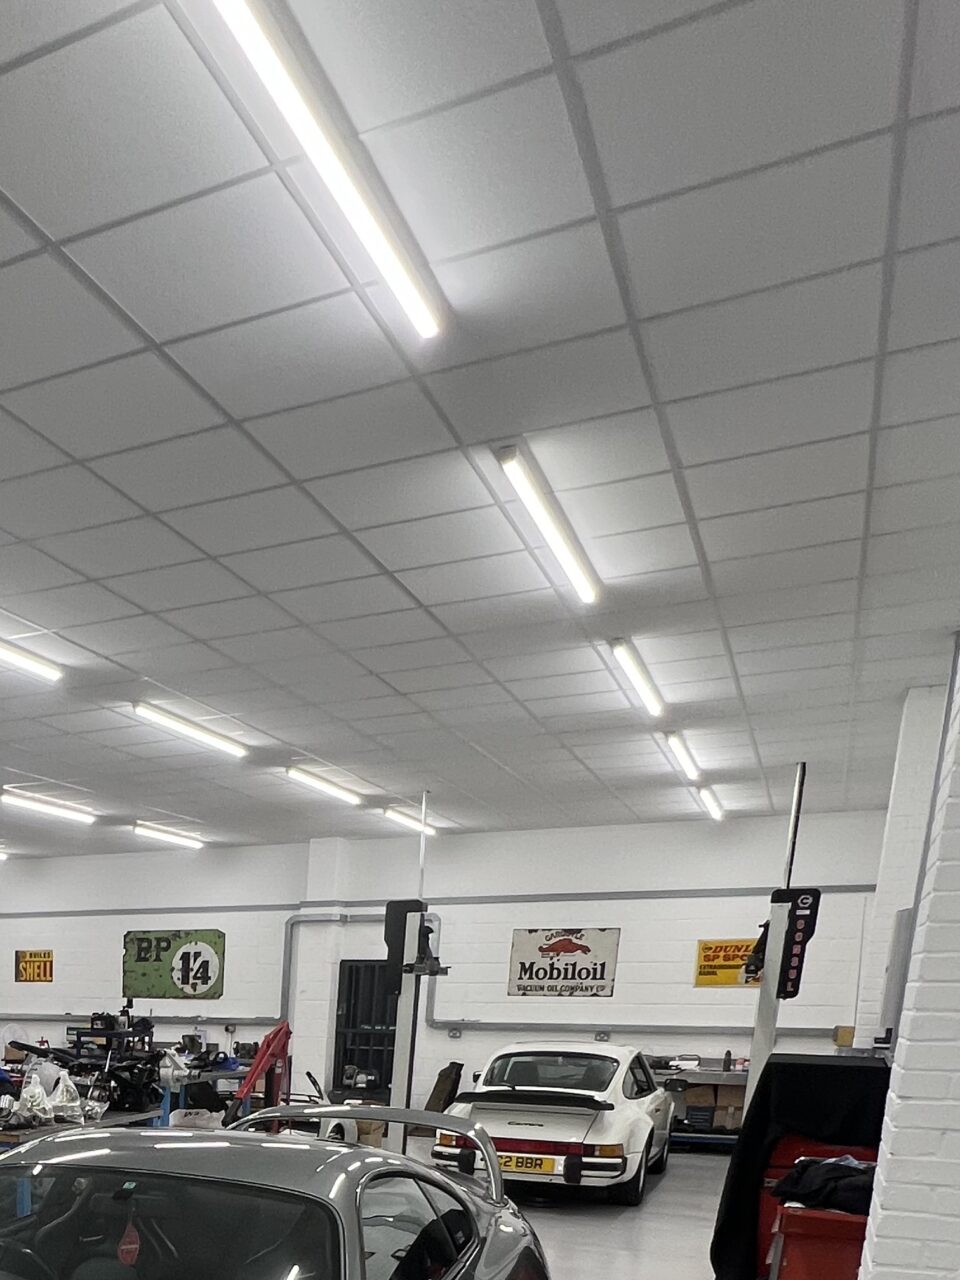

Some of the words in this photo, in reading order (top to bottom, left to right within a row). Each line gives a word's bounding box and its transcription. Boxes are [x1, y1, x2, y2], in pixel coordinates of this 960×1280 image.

[135, 937, 171, 962] BP
[712, 944, 752, 953] DUNL
[19, 961, 52, 981] SHELL
[517, 961, 606, 981] Mobiloil
[516, 984, 545, 992] VACUUM
[547, 984, 559, 992] OIL
[559, 984, 595, 993] COMPANY
